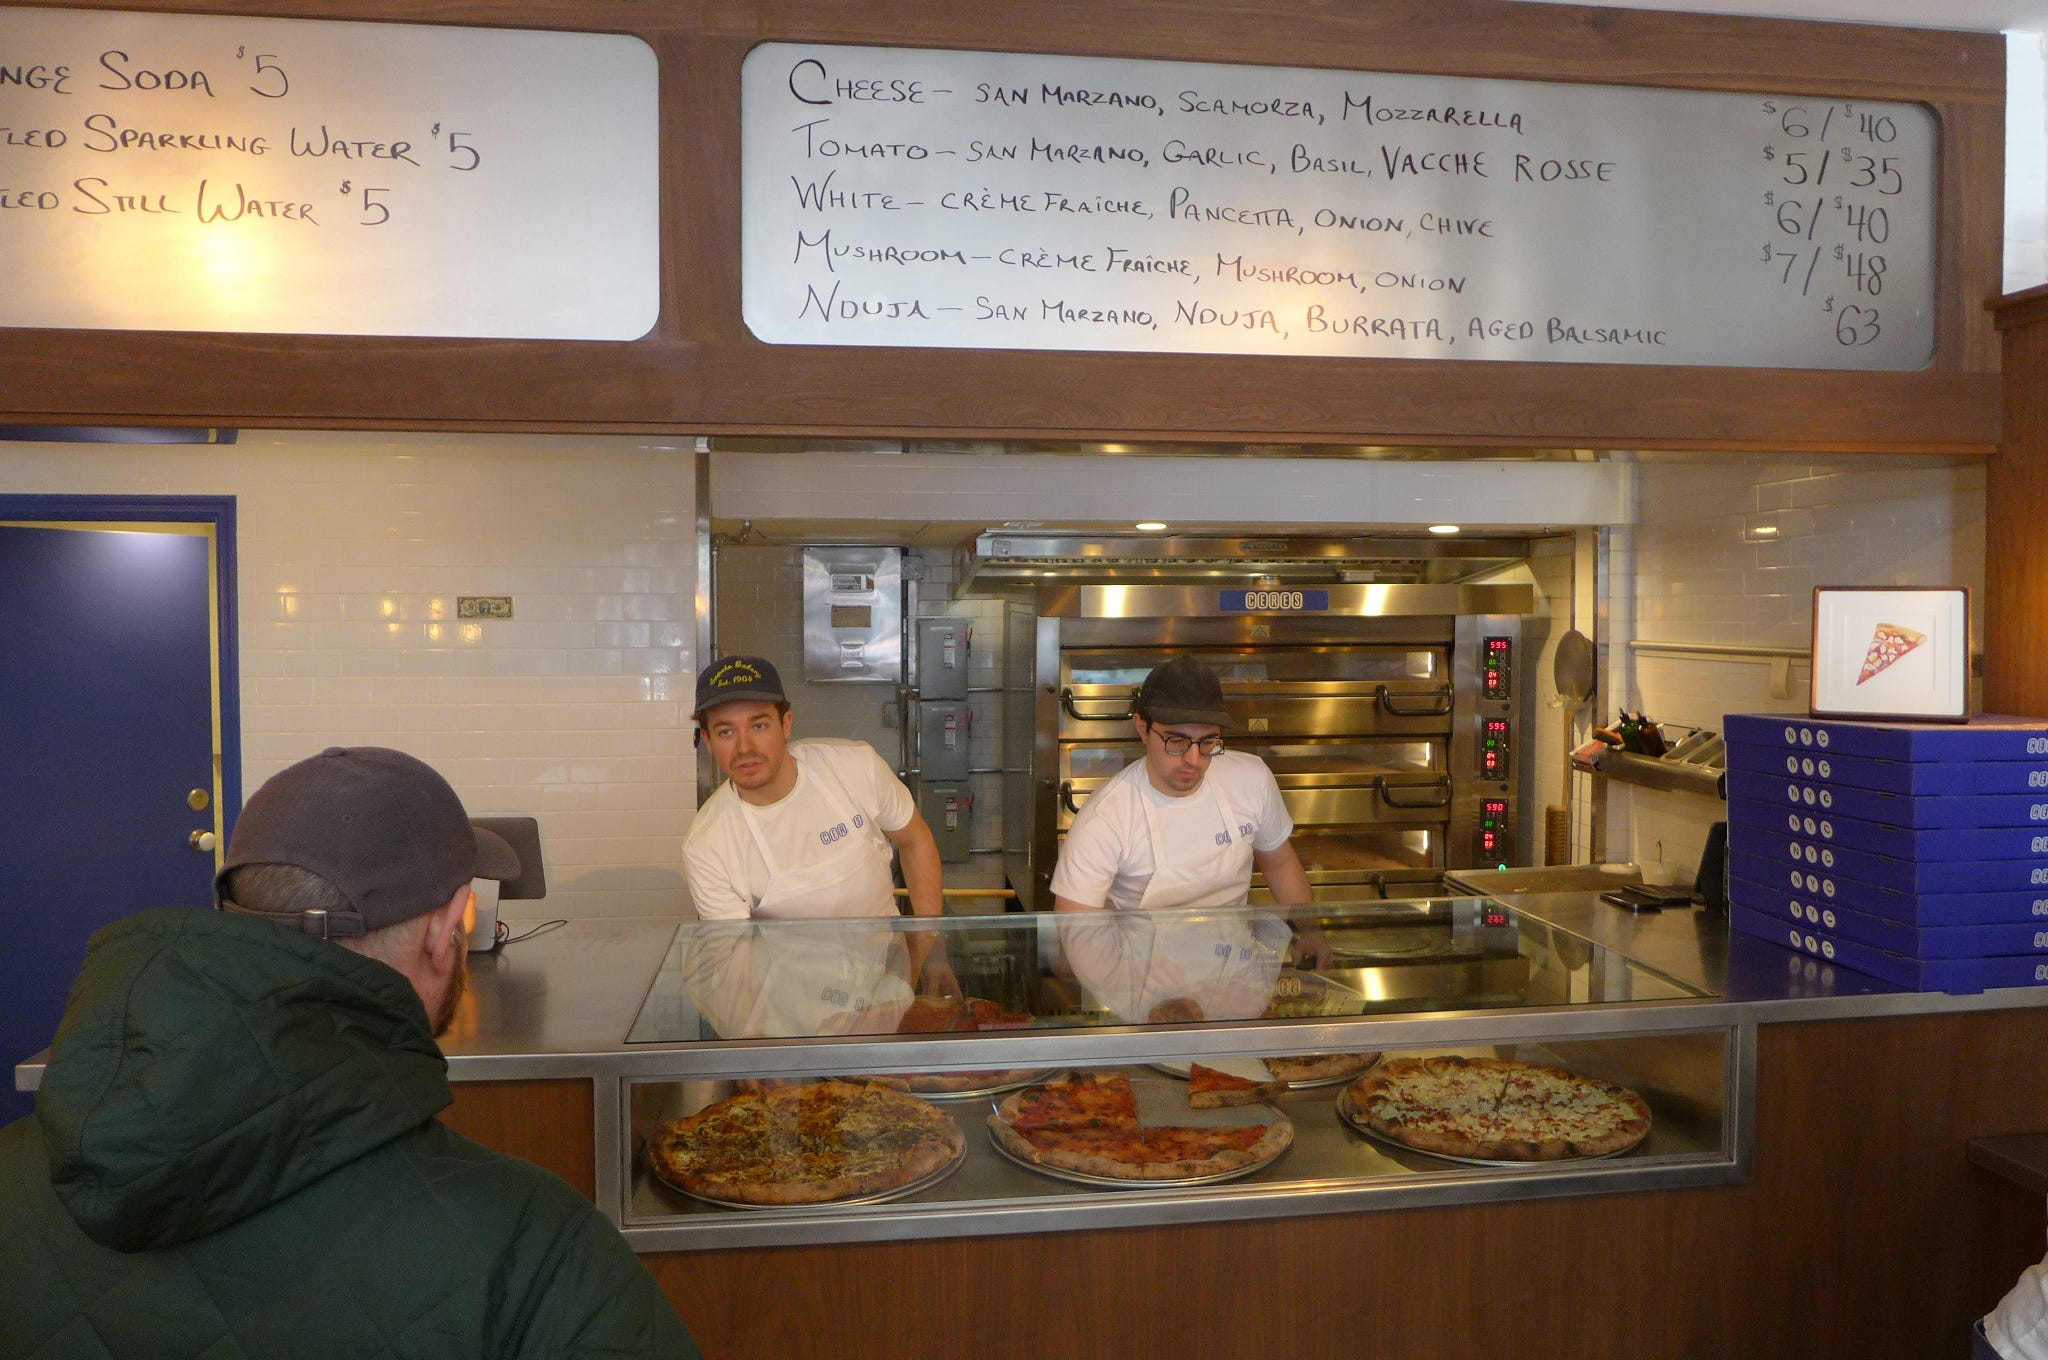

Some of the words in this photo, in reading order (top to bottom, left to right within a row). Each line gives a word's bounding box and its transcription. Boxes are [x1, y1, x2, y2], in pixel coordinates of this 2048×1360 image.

[99, 50, 215, 98] SODA
[976, 83, 1028, 106] SAN
[1042, 84, 1165, 117] MARZANO,
[1179, 91, 1325, 126] SCAMORZA,
[1342, 90, 1524, 135] MOZZARELLA
[84, 114, 272, 156] SPARKLING
[291, 124, 421, 168] WATER
[966, 140, 1017, 162] SAN
[1031, 136, 1150, 168] MARZANO,
[1162, 139, 1277, 176] GARLIC,
[1380, 145, 1489, 180] VACCHE
[1515, 153, 1618, 183] ROSSE
[73, 177, 182, 215] STILL
[197, 178, 320, 226] WATER
[1170, 187, 1304, 237] PANCETTA,
[1314, 208, 1411, 238] ONION,
[1420, 212, 1495, 238] CHIVE
[1216, 253, 1366, 294] MUSHROOM,
[1375, 271, 1466, 294] ONION
[977, 296, 1028, 321] SAN
[1042, 299, 1157, 331] MARZANO,
[1174, 299, 1289, 340] NDUJA,
[1307, 304, 1456, 345] BURRATA,
[1468, 316, 1535, 341] AGED
[1547, 316, 1667, 346] BALSAMIC
[1246, 592, 1303, 609] CERES
[1489, 641, 1507, 649] 595
[1488, 722, 1505, 730] 595
[820, 814, 864, 845] CERS
